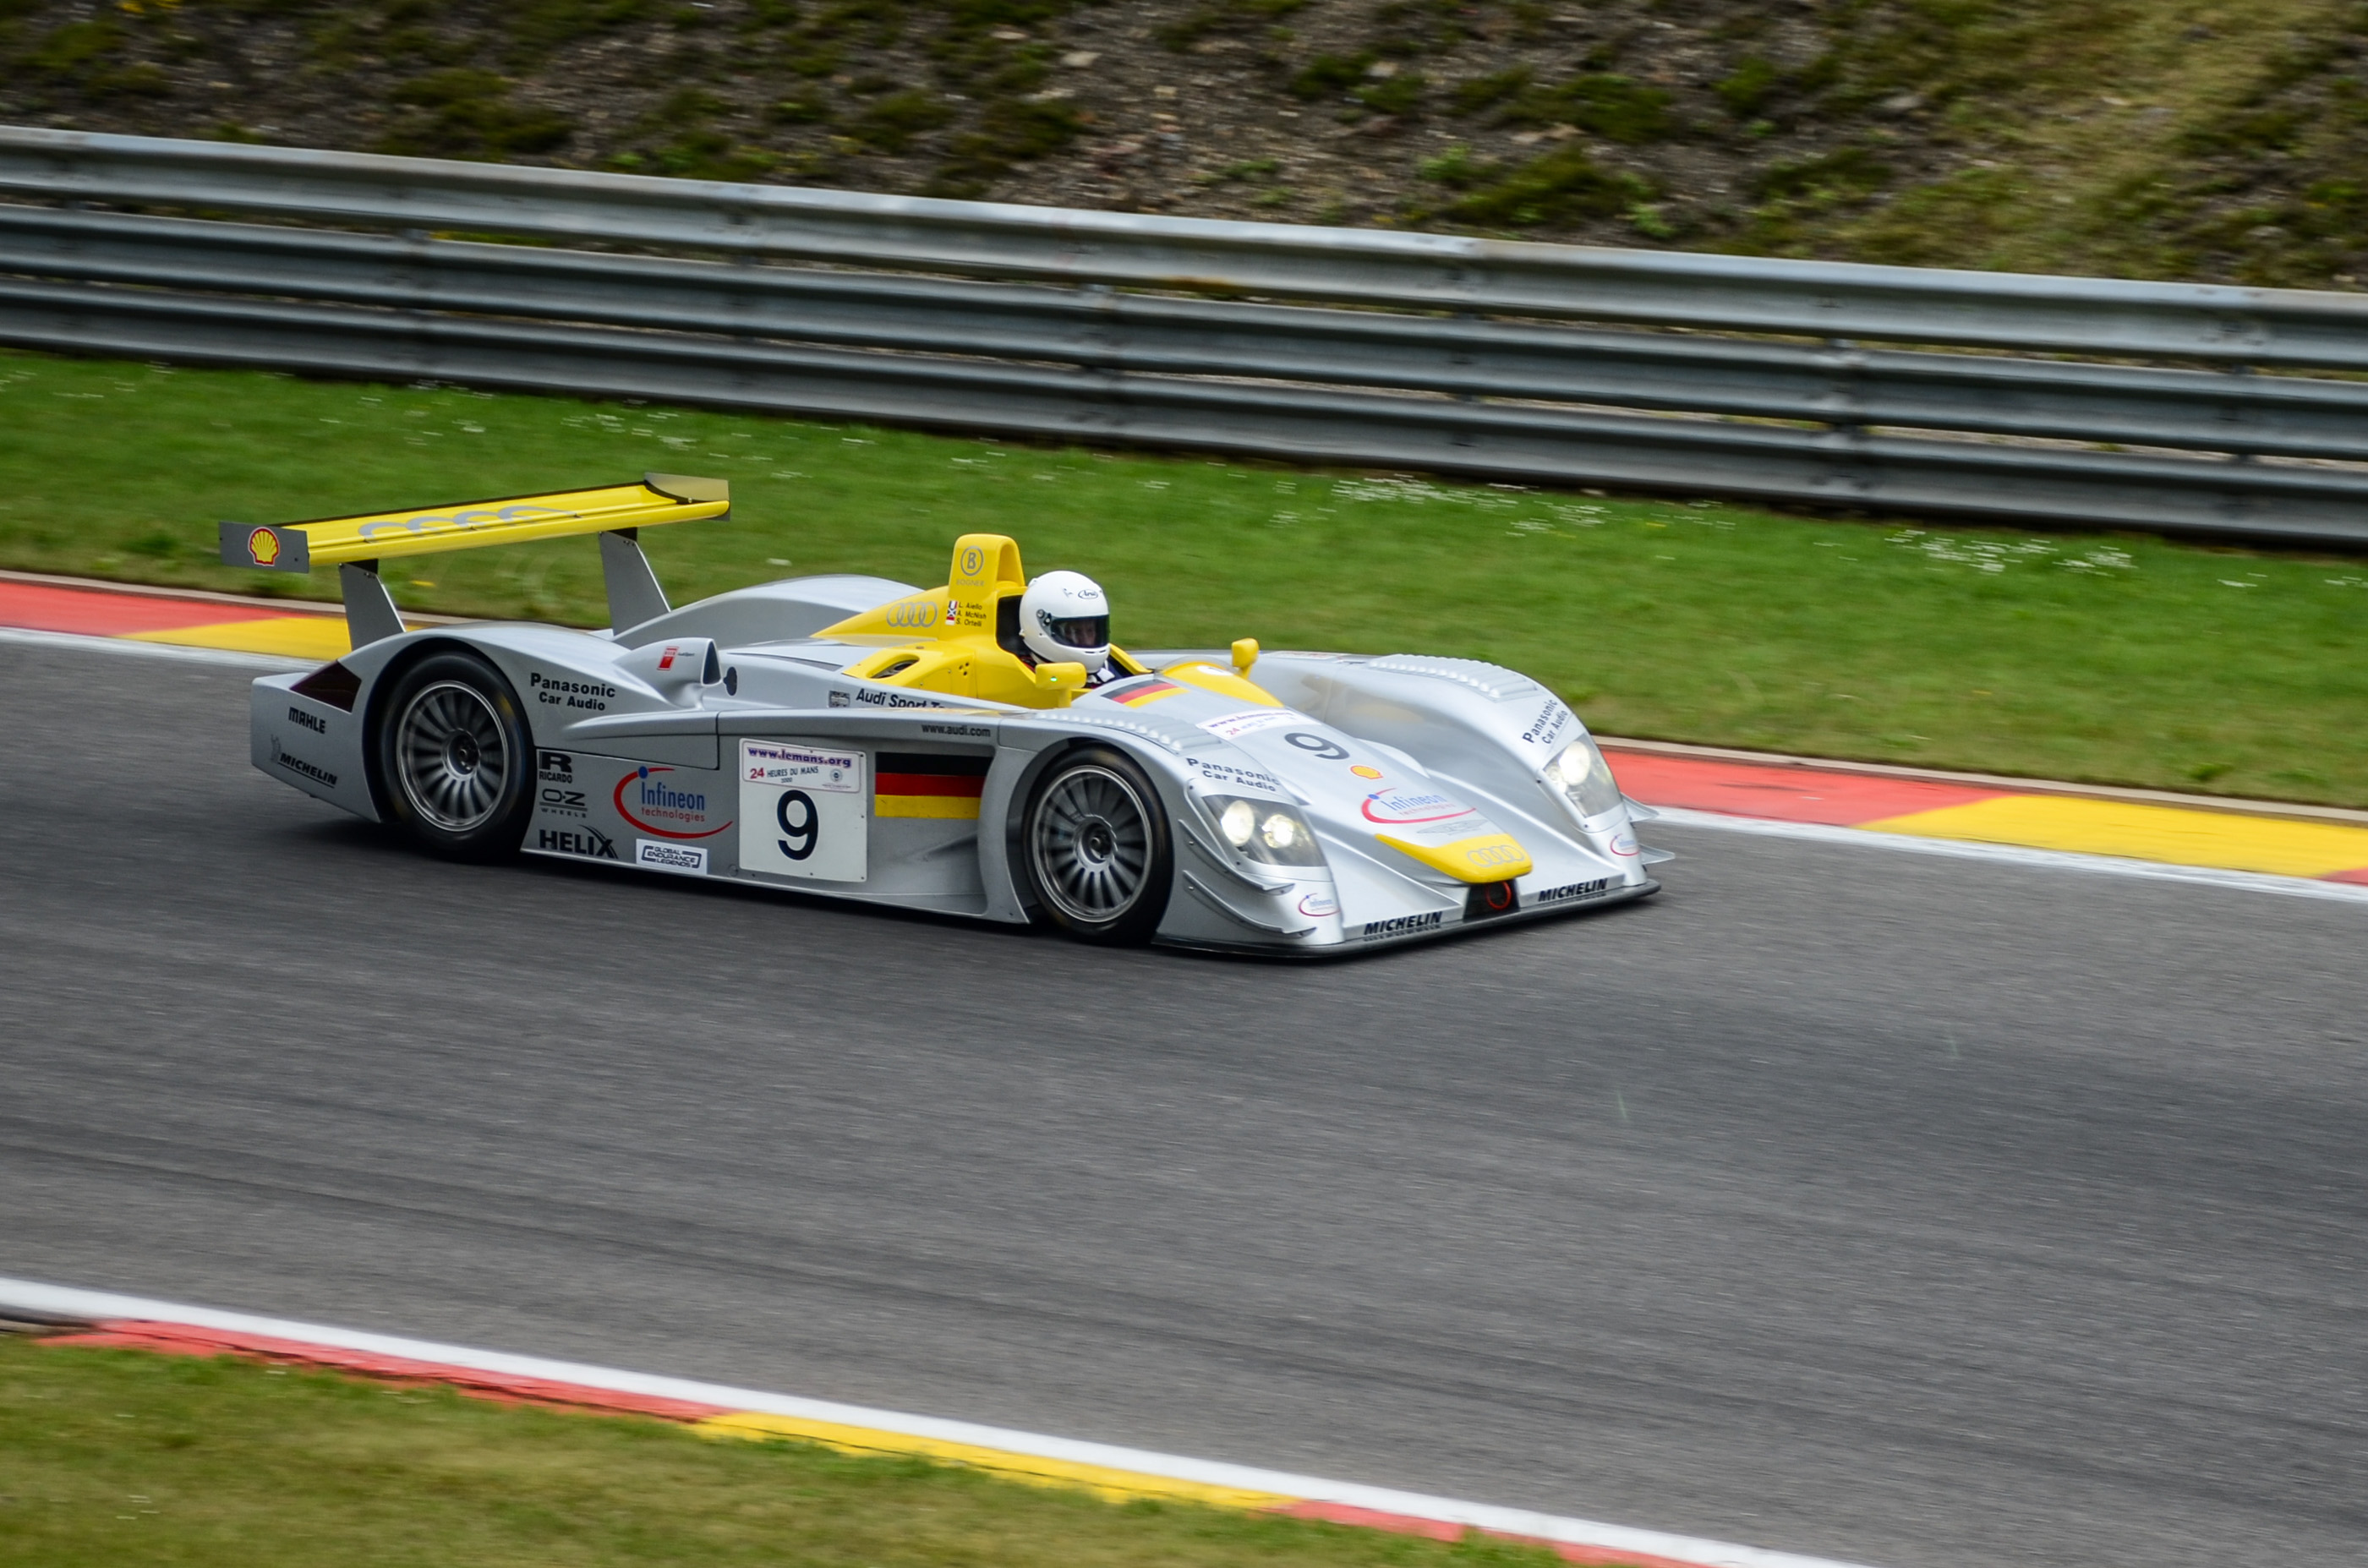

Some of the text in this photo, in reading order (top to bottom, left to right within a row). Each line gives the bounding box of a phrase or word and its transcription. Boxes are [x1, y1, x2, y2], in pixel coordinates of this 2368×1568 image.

[966, 552, 977, 570] B
[965, 610, 987, 619] McNish
[530, 672, 615, 697] Panasonic
[539, 691, 605, 711] Car Audio
[856, 688, 887, 706] Audi
[288, 707, 325, 735] MAHLE
[921, 724, 991, 737] www.audi.com
[1522, 699, 1558, 744] Panasonic
[1542, 710, 1568, 744] Car Audio
[747, 746, 852, 768] www.lemans.org
[1283, 732, 1350, 760] 9
[280, 752, 337, 785] MICHELIN
[539, 751, 572, 773] R
[750, 766, 819, 779] 24 HEURES DU MANS
[1186, 757, 1281, 785] Panasonic
[539, 771, 572, 784] RICARDO
[1202, 770, 1276, 792] Car Audio
[541, 808, 586, 818] WHEELS
[642, 806, 705, 822] technologies
[776, 789, 819, 861] 9
[539, 829, 618, 859] HELIX
[654, 846, 680, 855] GLOBAL
[647, 850, 696, 863] ENDURANCE
[657, 858, 691, 868] LEGENDS
[1538, 877, 1608, 902] MICHELIN
[1364, 911, 1443, 935] MICHELIN
